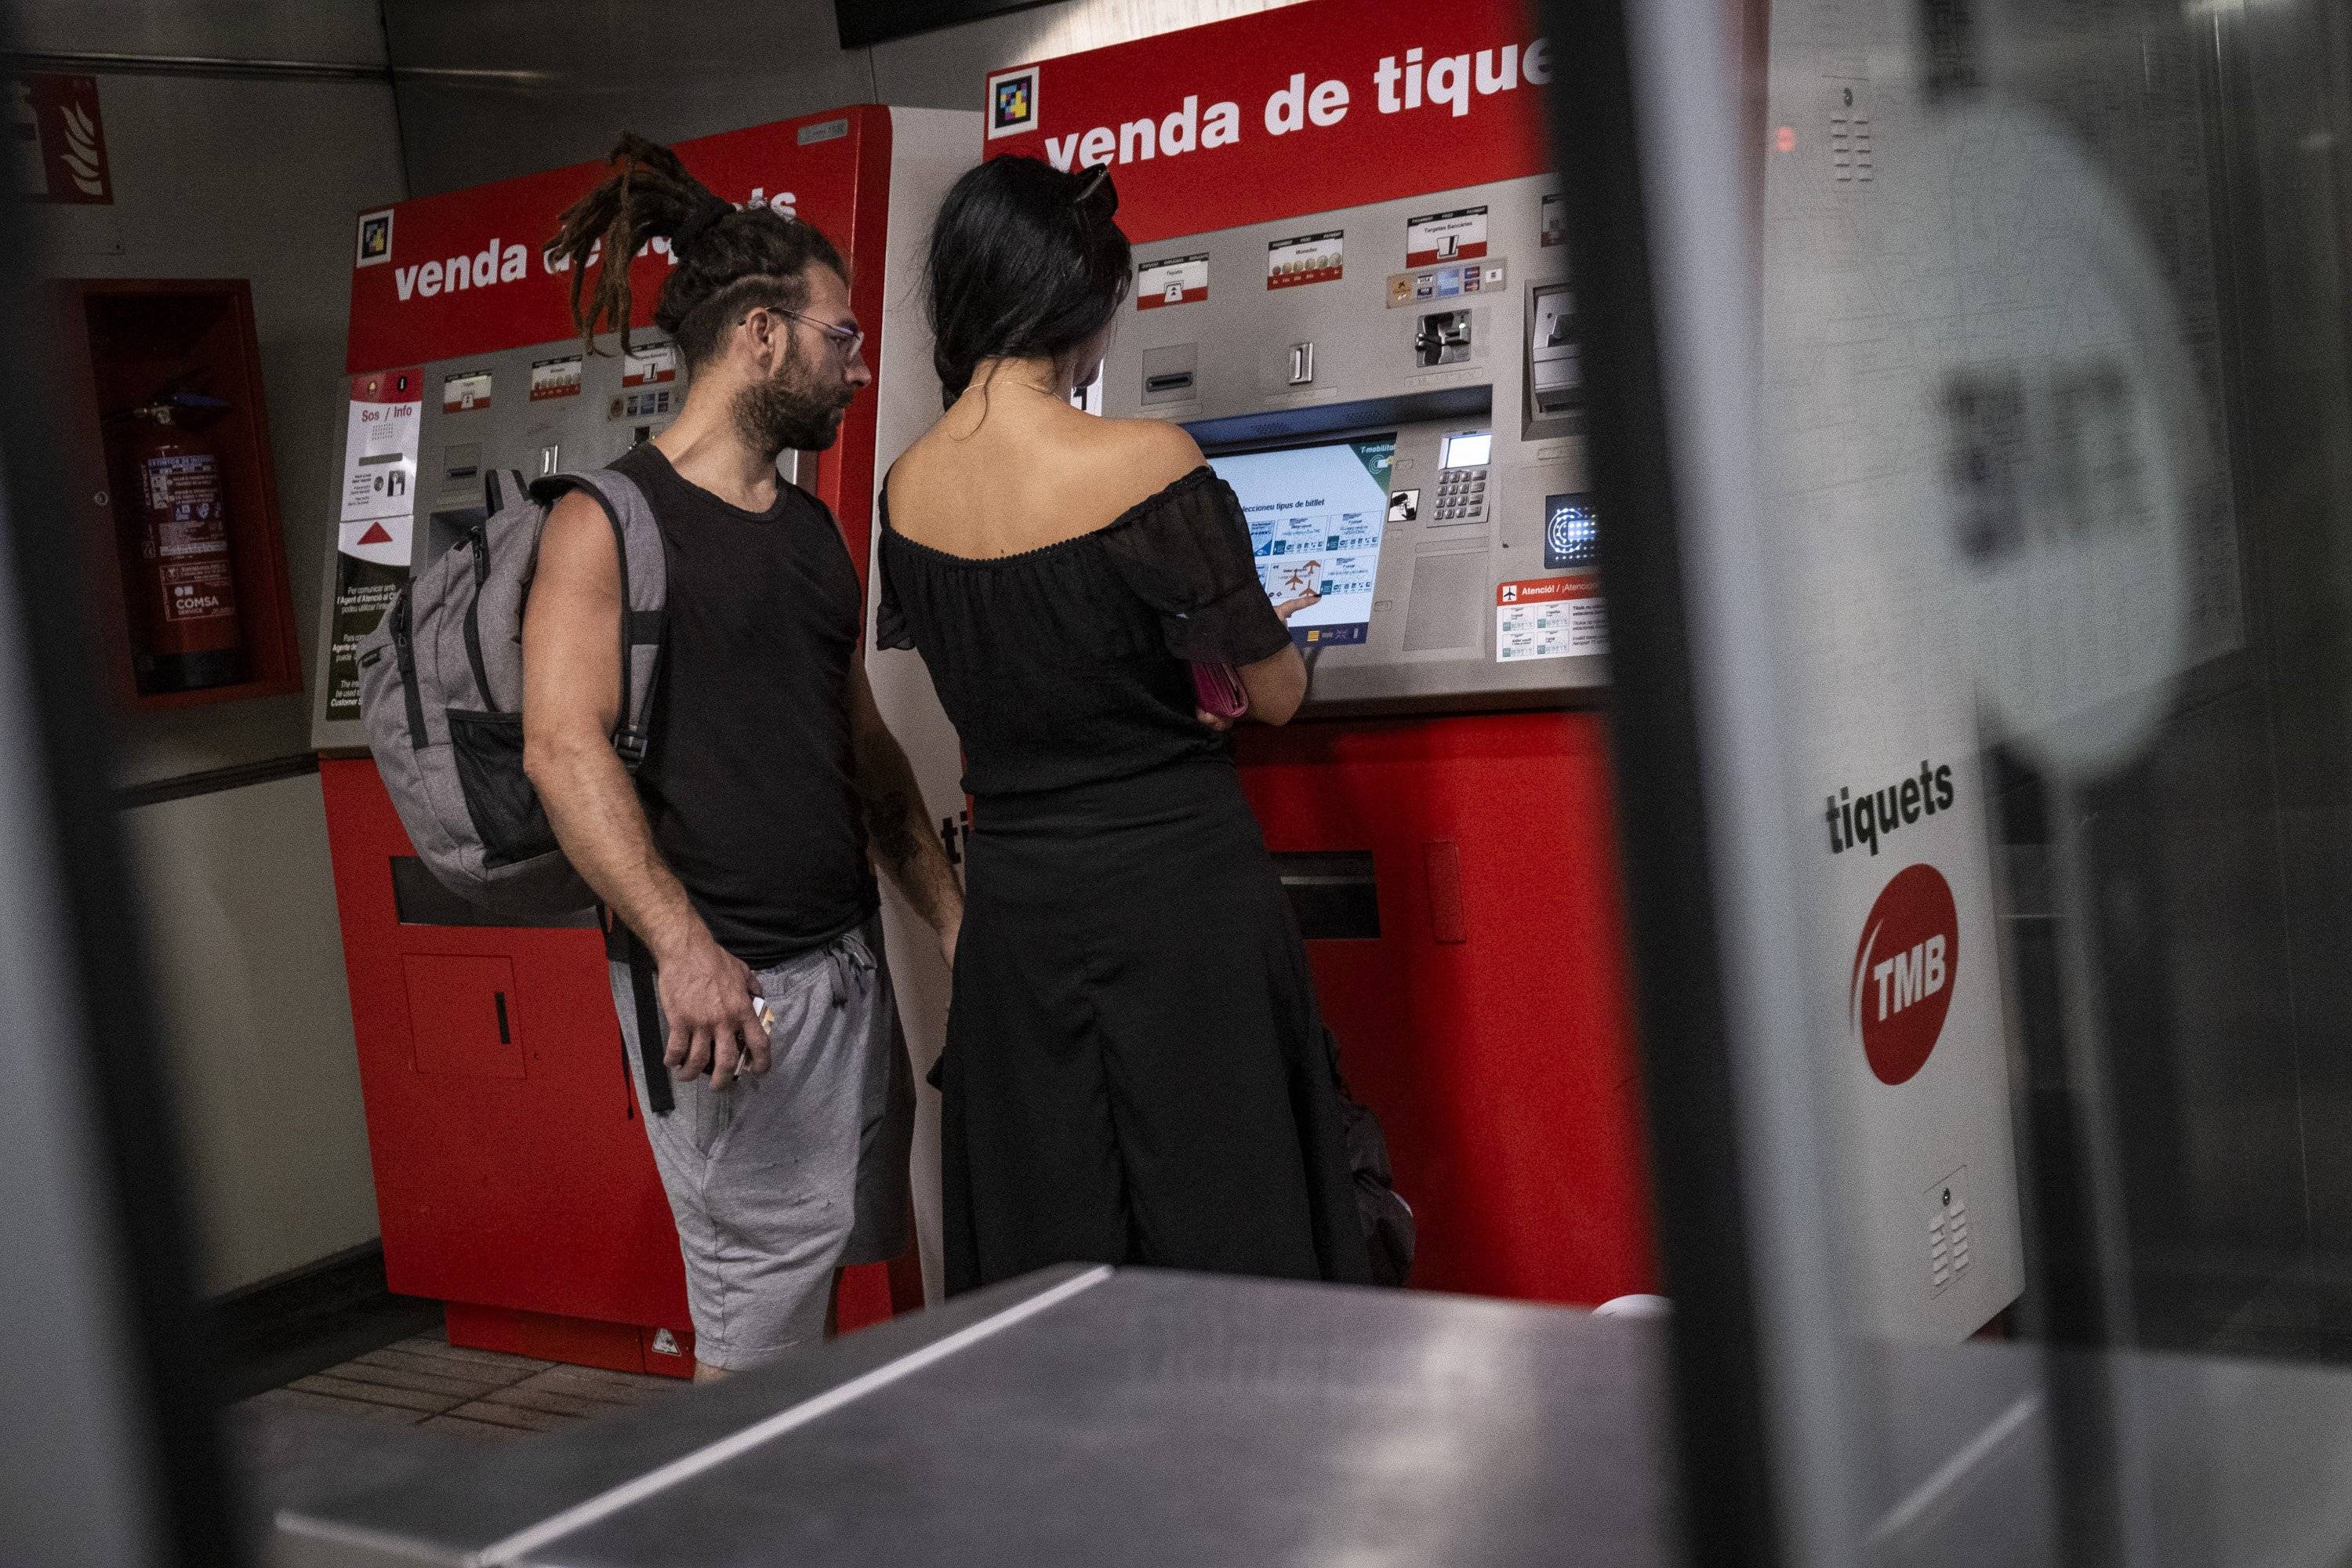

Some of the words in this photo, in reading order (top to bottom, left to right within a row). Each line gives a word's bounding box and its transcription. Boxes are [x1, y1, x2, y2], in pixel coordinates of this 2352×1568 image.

[1044, 95, 1240, 173] venda
[1264, 72, 1350, 136] de
[1373, 37, 1555, 118] tique
[394, 238, 528, 302] venda
[361, 409, 379, 423] Sos
[394, 405, 412, 418] Info
[1242, 503, 1275, 513] leccioneu
[1276, 501, 1294, 511] tipus
[1305, 499, 1325, 508] bitllet
[1521, 585, 1555, 596] Atenció!
[175, 596, 220, 610] COMSA
[330, 699, 358, 707] Customer
[1825, 759, 1955, 856] tiquets
[1873, 933, 1947, 1022] TMB
